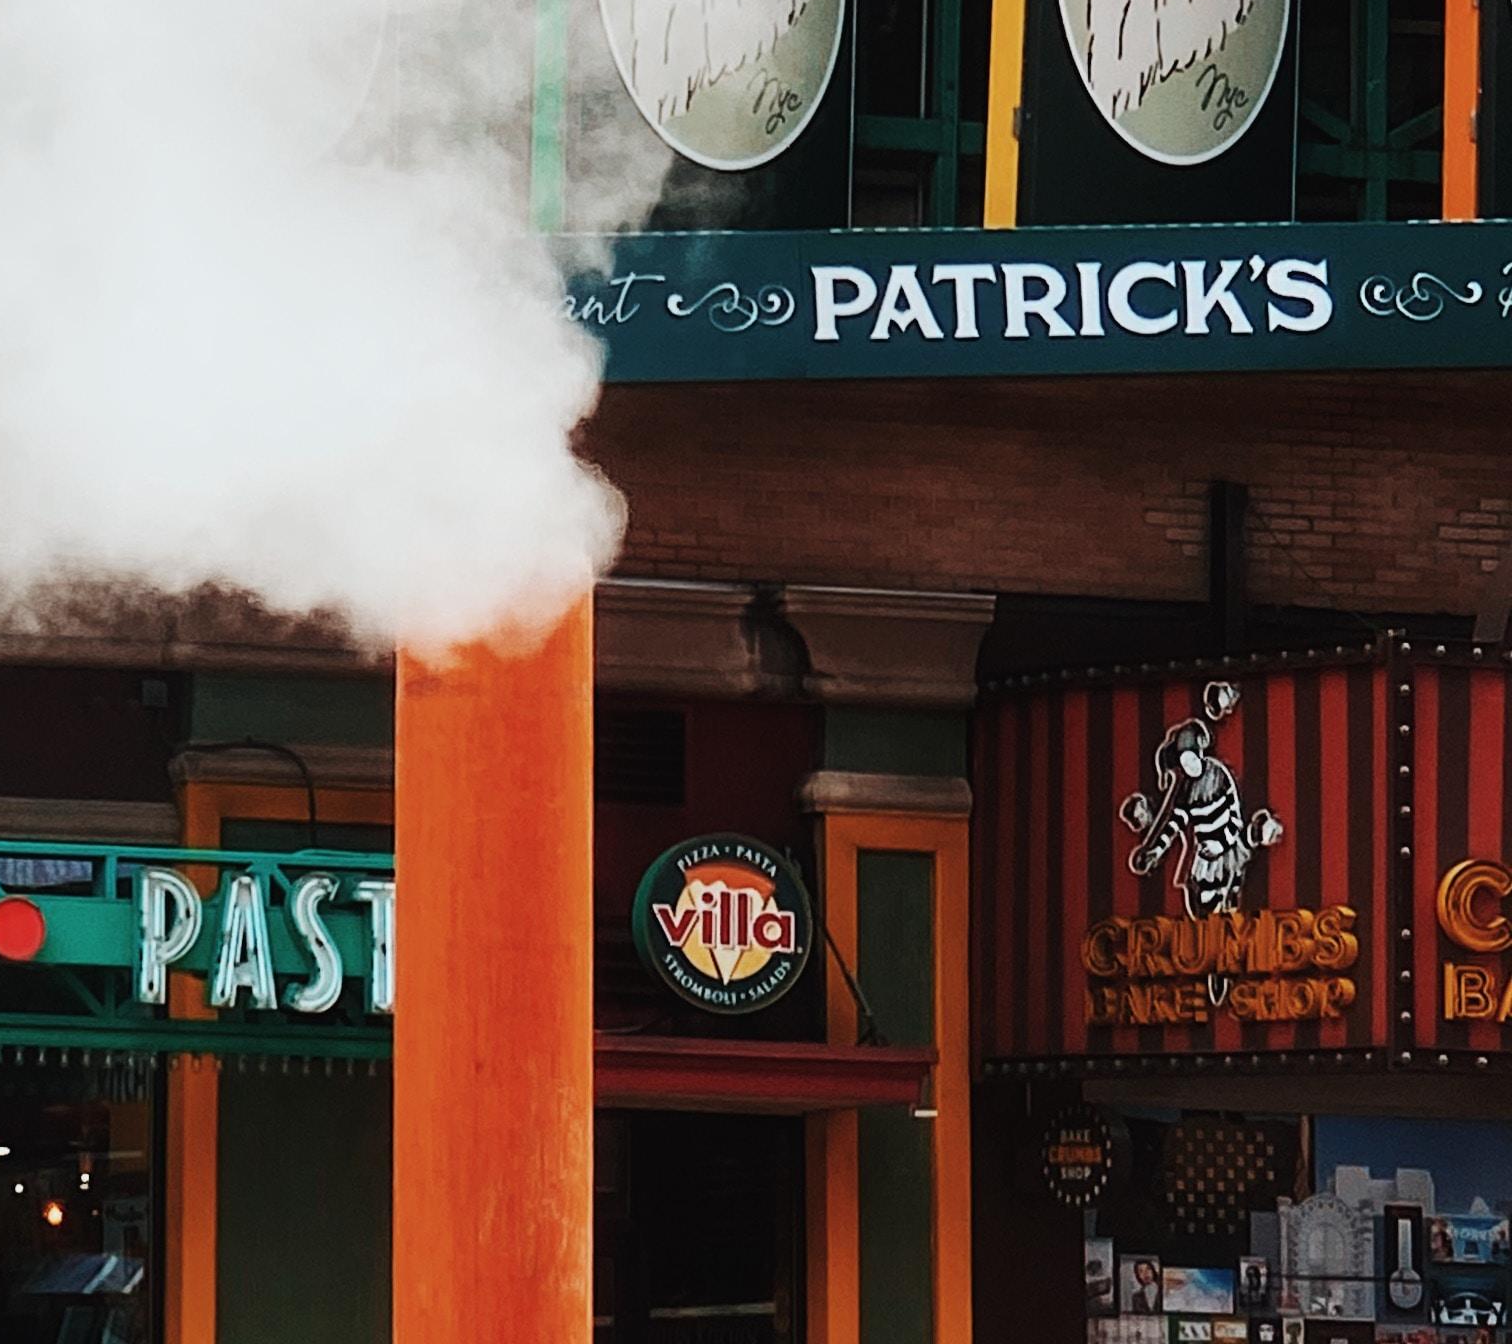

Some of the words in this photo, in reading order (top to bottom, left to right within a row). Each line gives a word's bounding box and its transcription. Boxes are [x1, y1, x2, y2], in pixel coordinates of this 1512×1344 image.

[811, 257, 1334, 341] PATRICK'S
[676, 844, 720, 873] PIZZA
[736, 845, 778, 878] PASTA
[652, 889, 796, 954] villa
[1081, 904, 1359, 978] CRUMBS
[664, 953, 737, 1005] STROMBOLI
[748, 960, 793, 1002] SALADS
